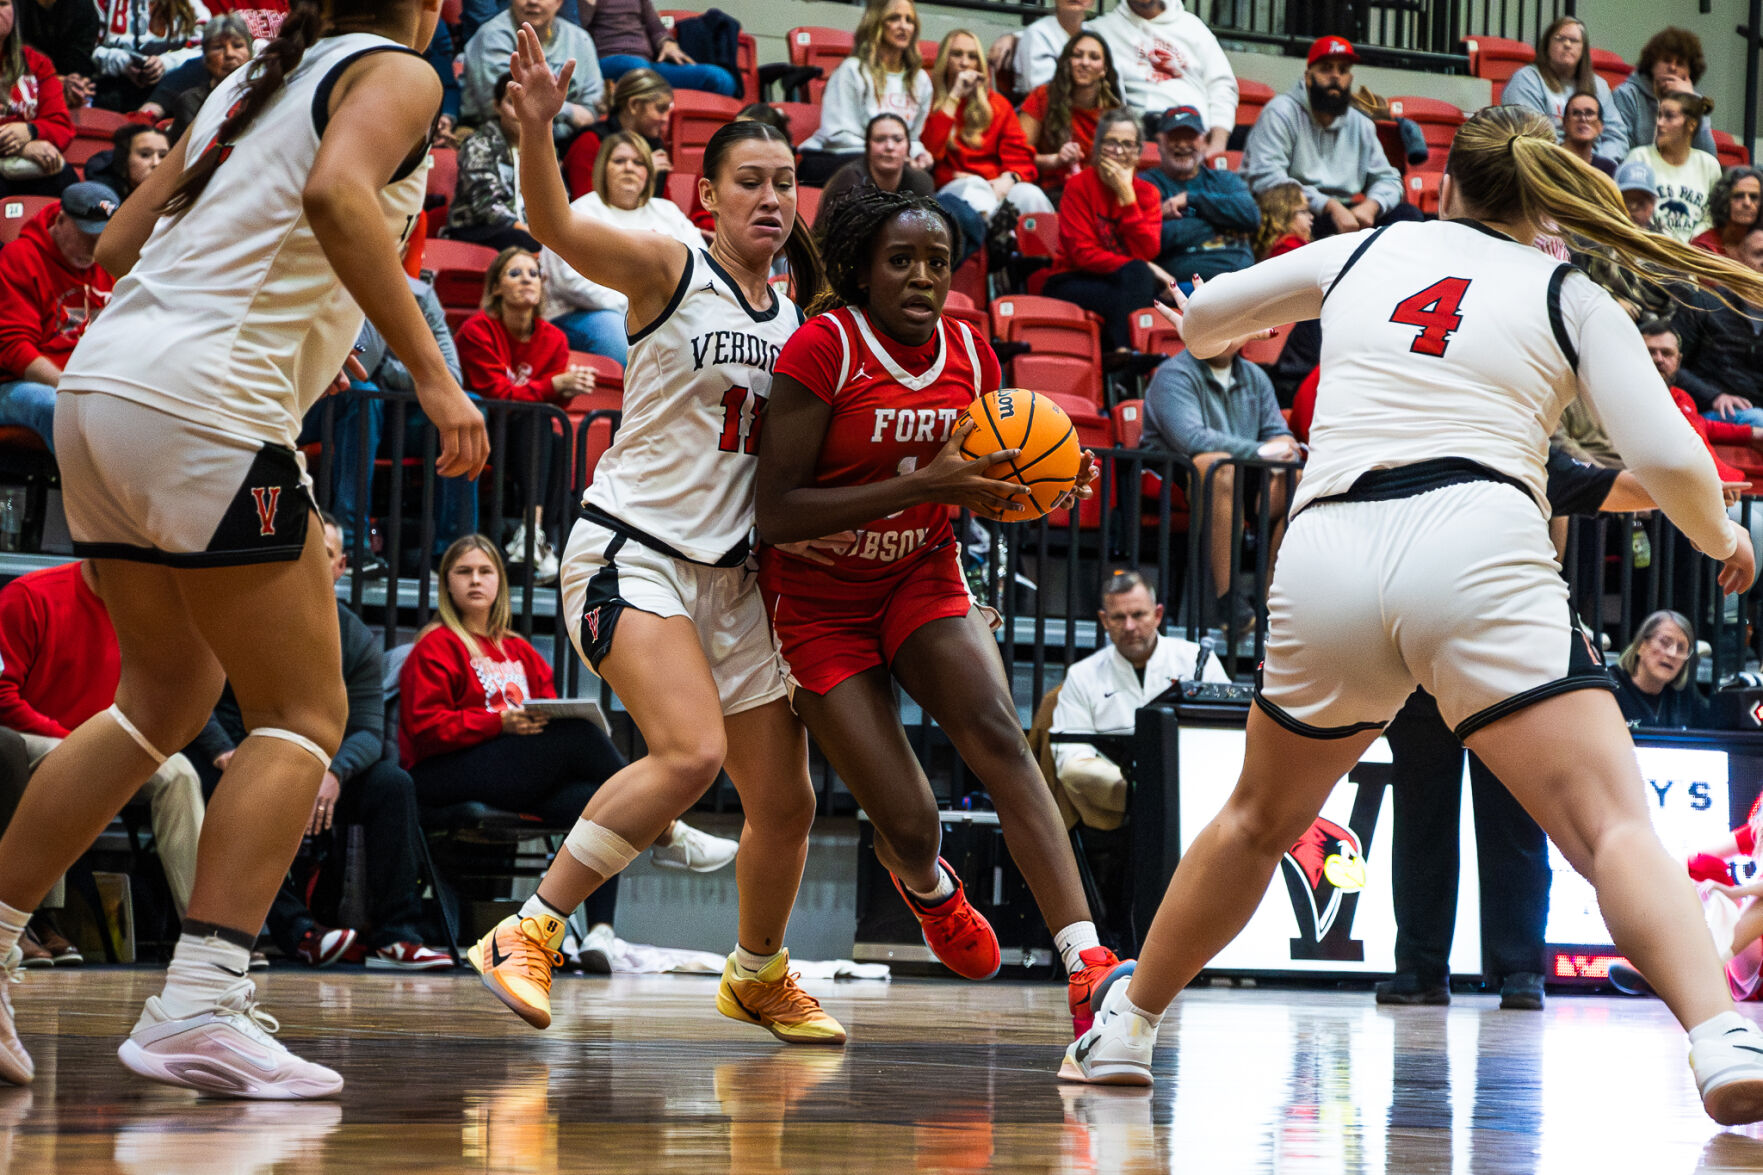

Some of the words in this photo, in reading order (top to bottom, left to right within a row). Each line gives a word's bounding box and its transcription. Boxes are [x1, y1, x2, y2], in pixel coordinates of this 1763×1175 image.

[1389, 276, 1473, 358] 4
[871, 408, 958, 443] FORT
[251, 486, 281, 536] V
[584, 606, 601, 643] V
[1649, 778, 1712, 811] YS
